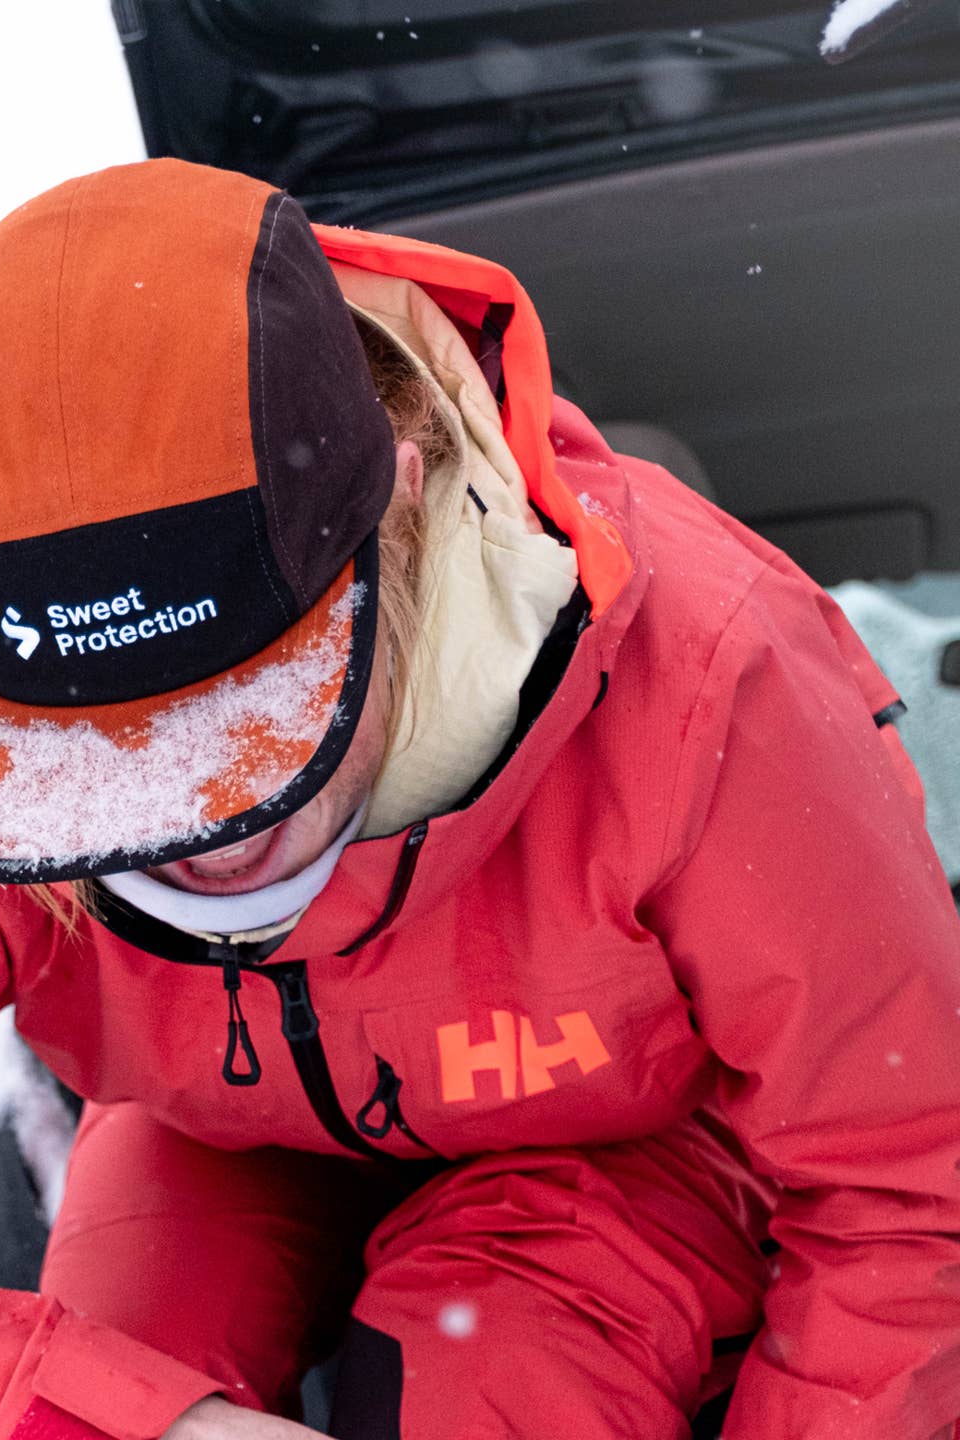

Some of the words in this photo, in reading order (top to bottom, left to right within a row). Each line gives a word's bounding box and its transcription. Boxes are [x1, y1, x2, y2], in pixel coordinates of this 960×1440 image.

[47, 588, 145, 628] Sweet
[55, 598, 217, 656] Protection
[436, 1010, 612, 1104] HH
